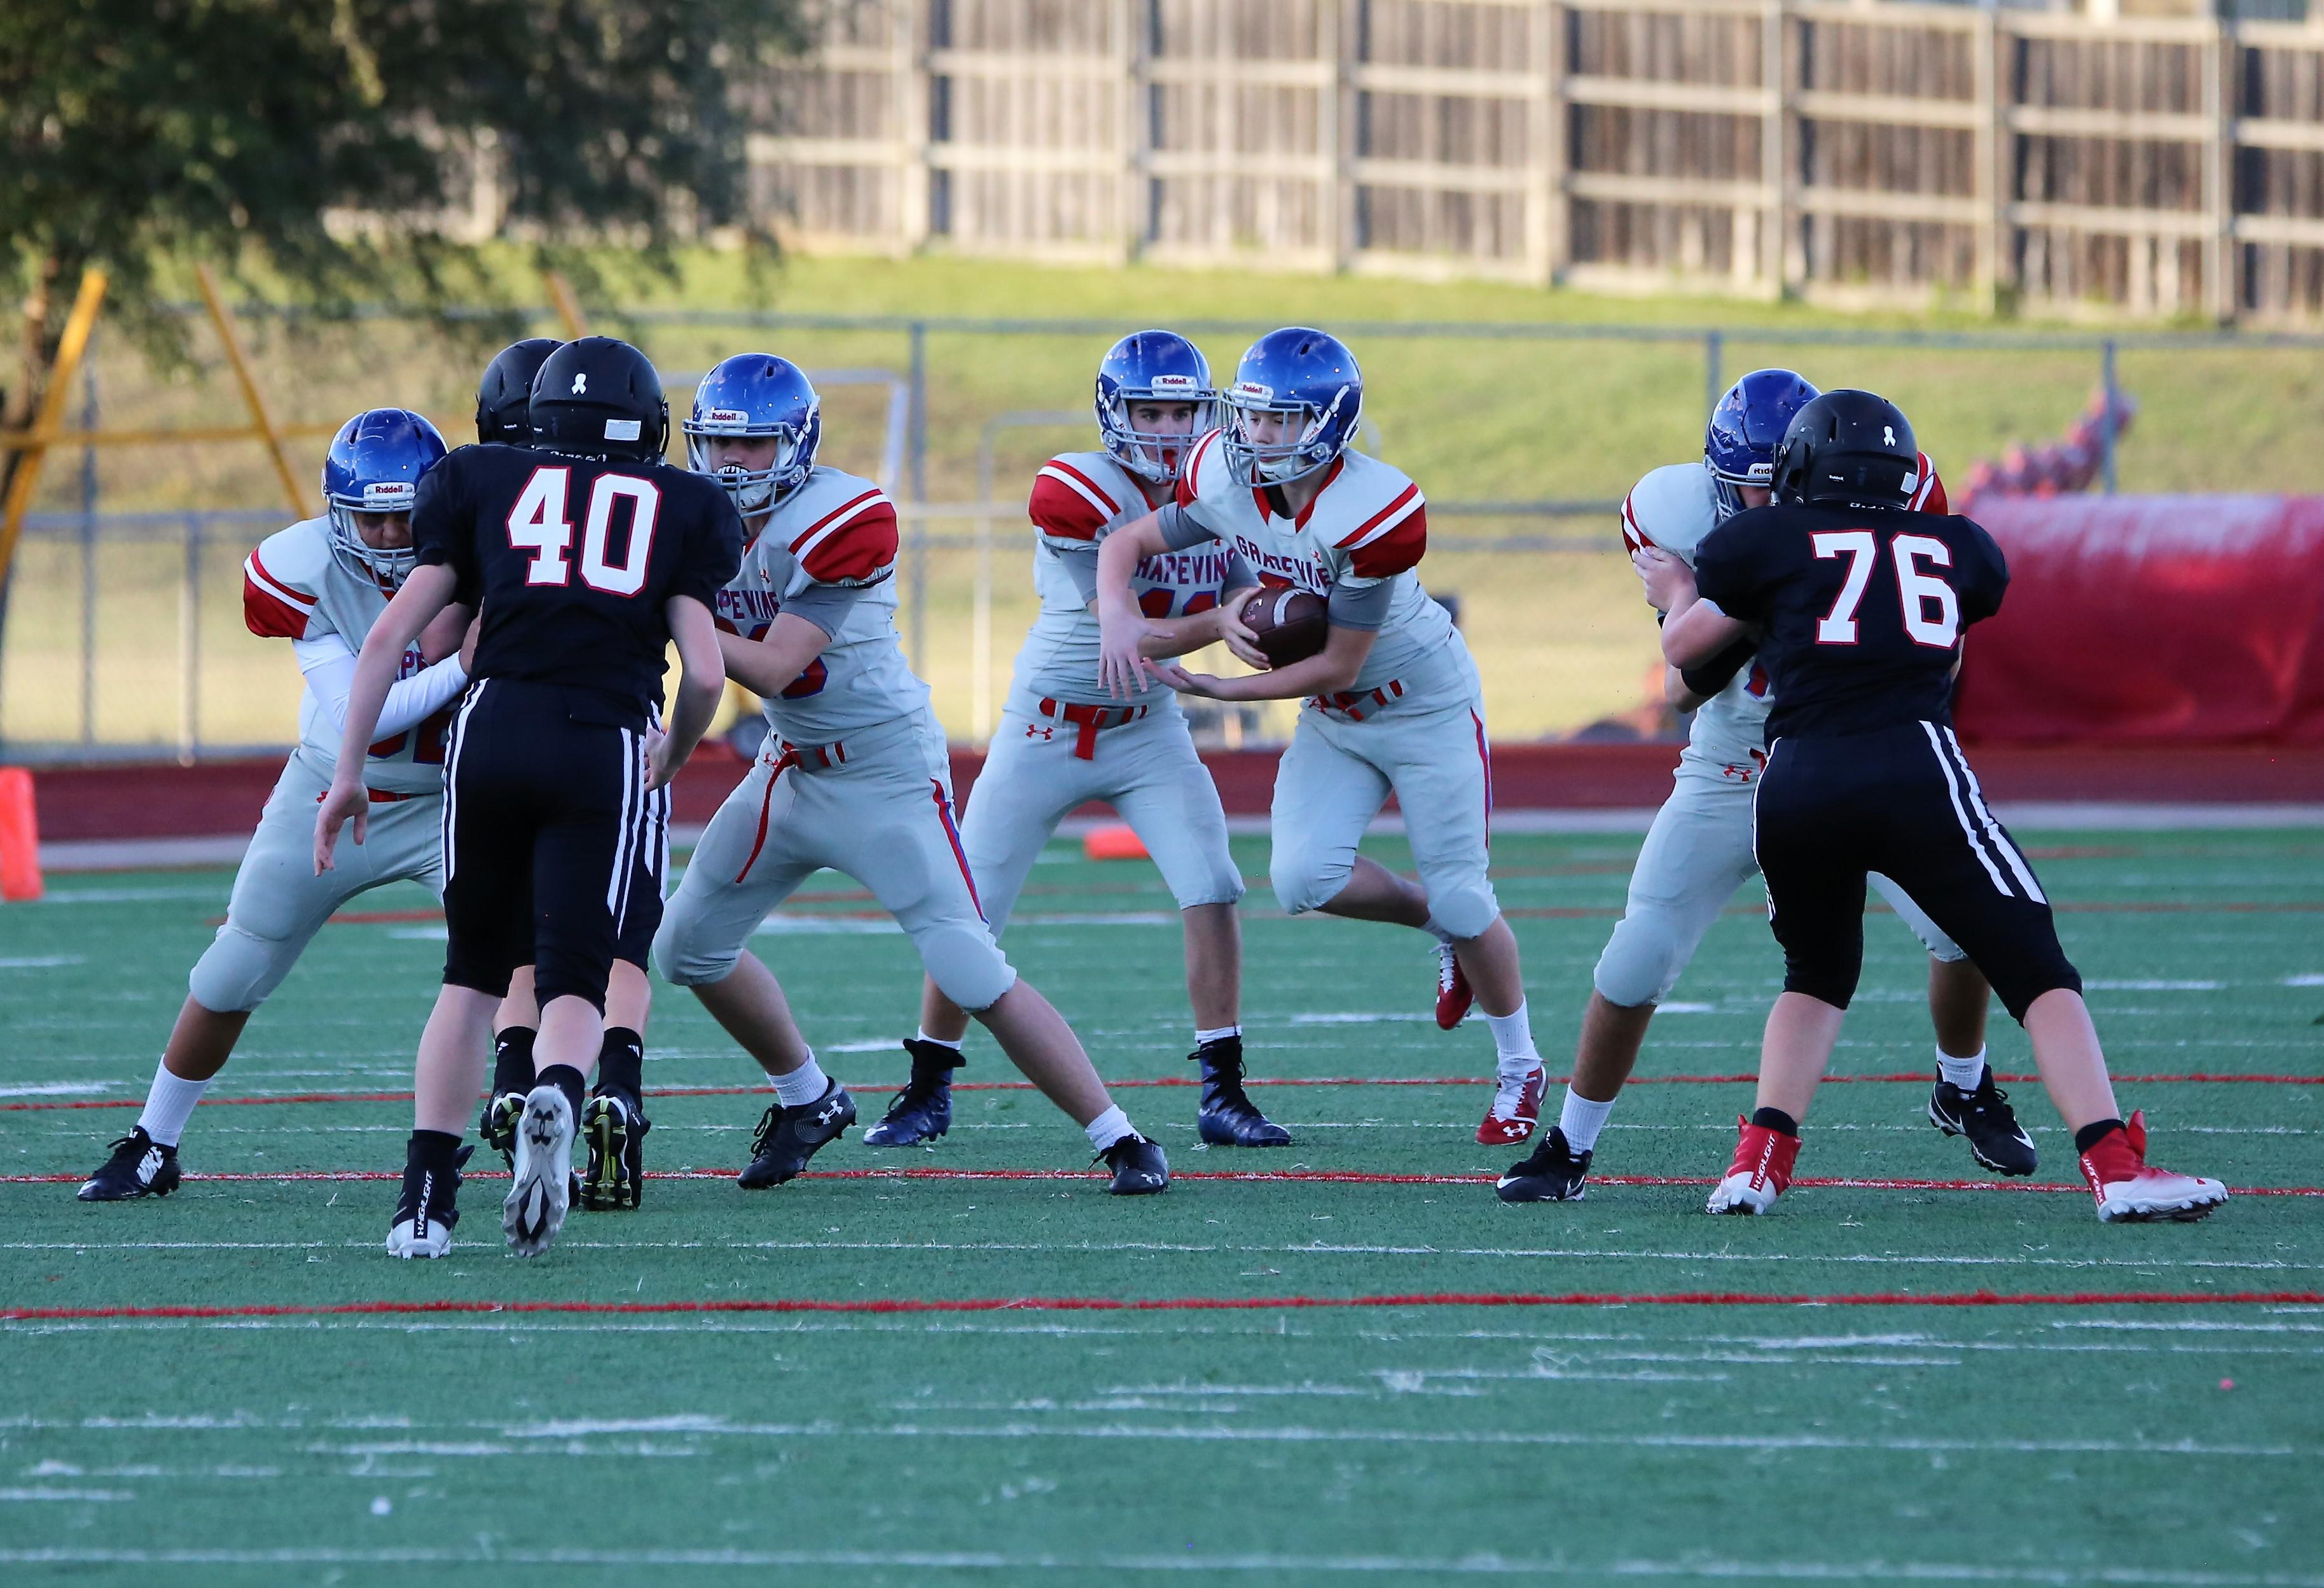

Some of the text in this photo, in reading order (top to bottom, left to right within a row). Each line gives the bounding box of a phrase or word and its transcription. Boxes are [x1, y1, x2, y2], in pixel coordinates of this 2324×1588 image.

[375, 485, 403, 494] Riddell
[505, 466, 663, 599] 40
[1135, 548, 1236, 584] RAPEVIN
[717, 589, 781, 619] PEVINE
[1808, 526, 1961, 650] 76
[1756, 1133, 1776, 1182] HIGHLIGHT
